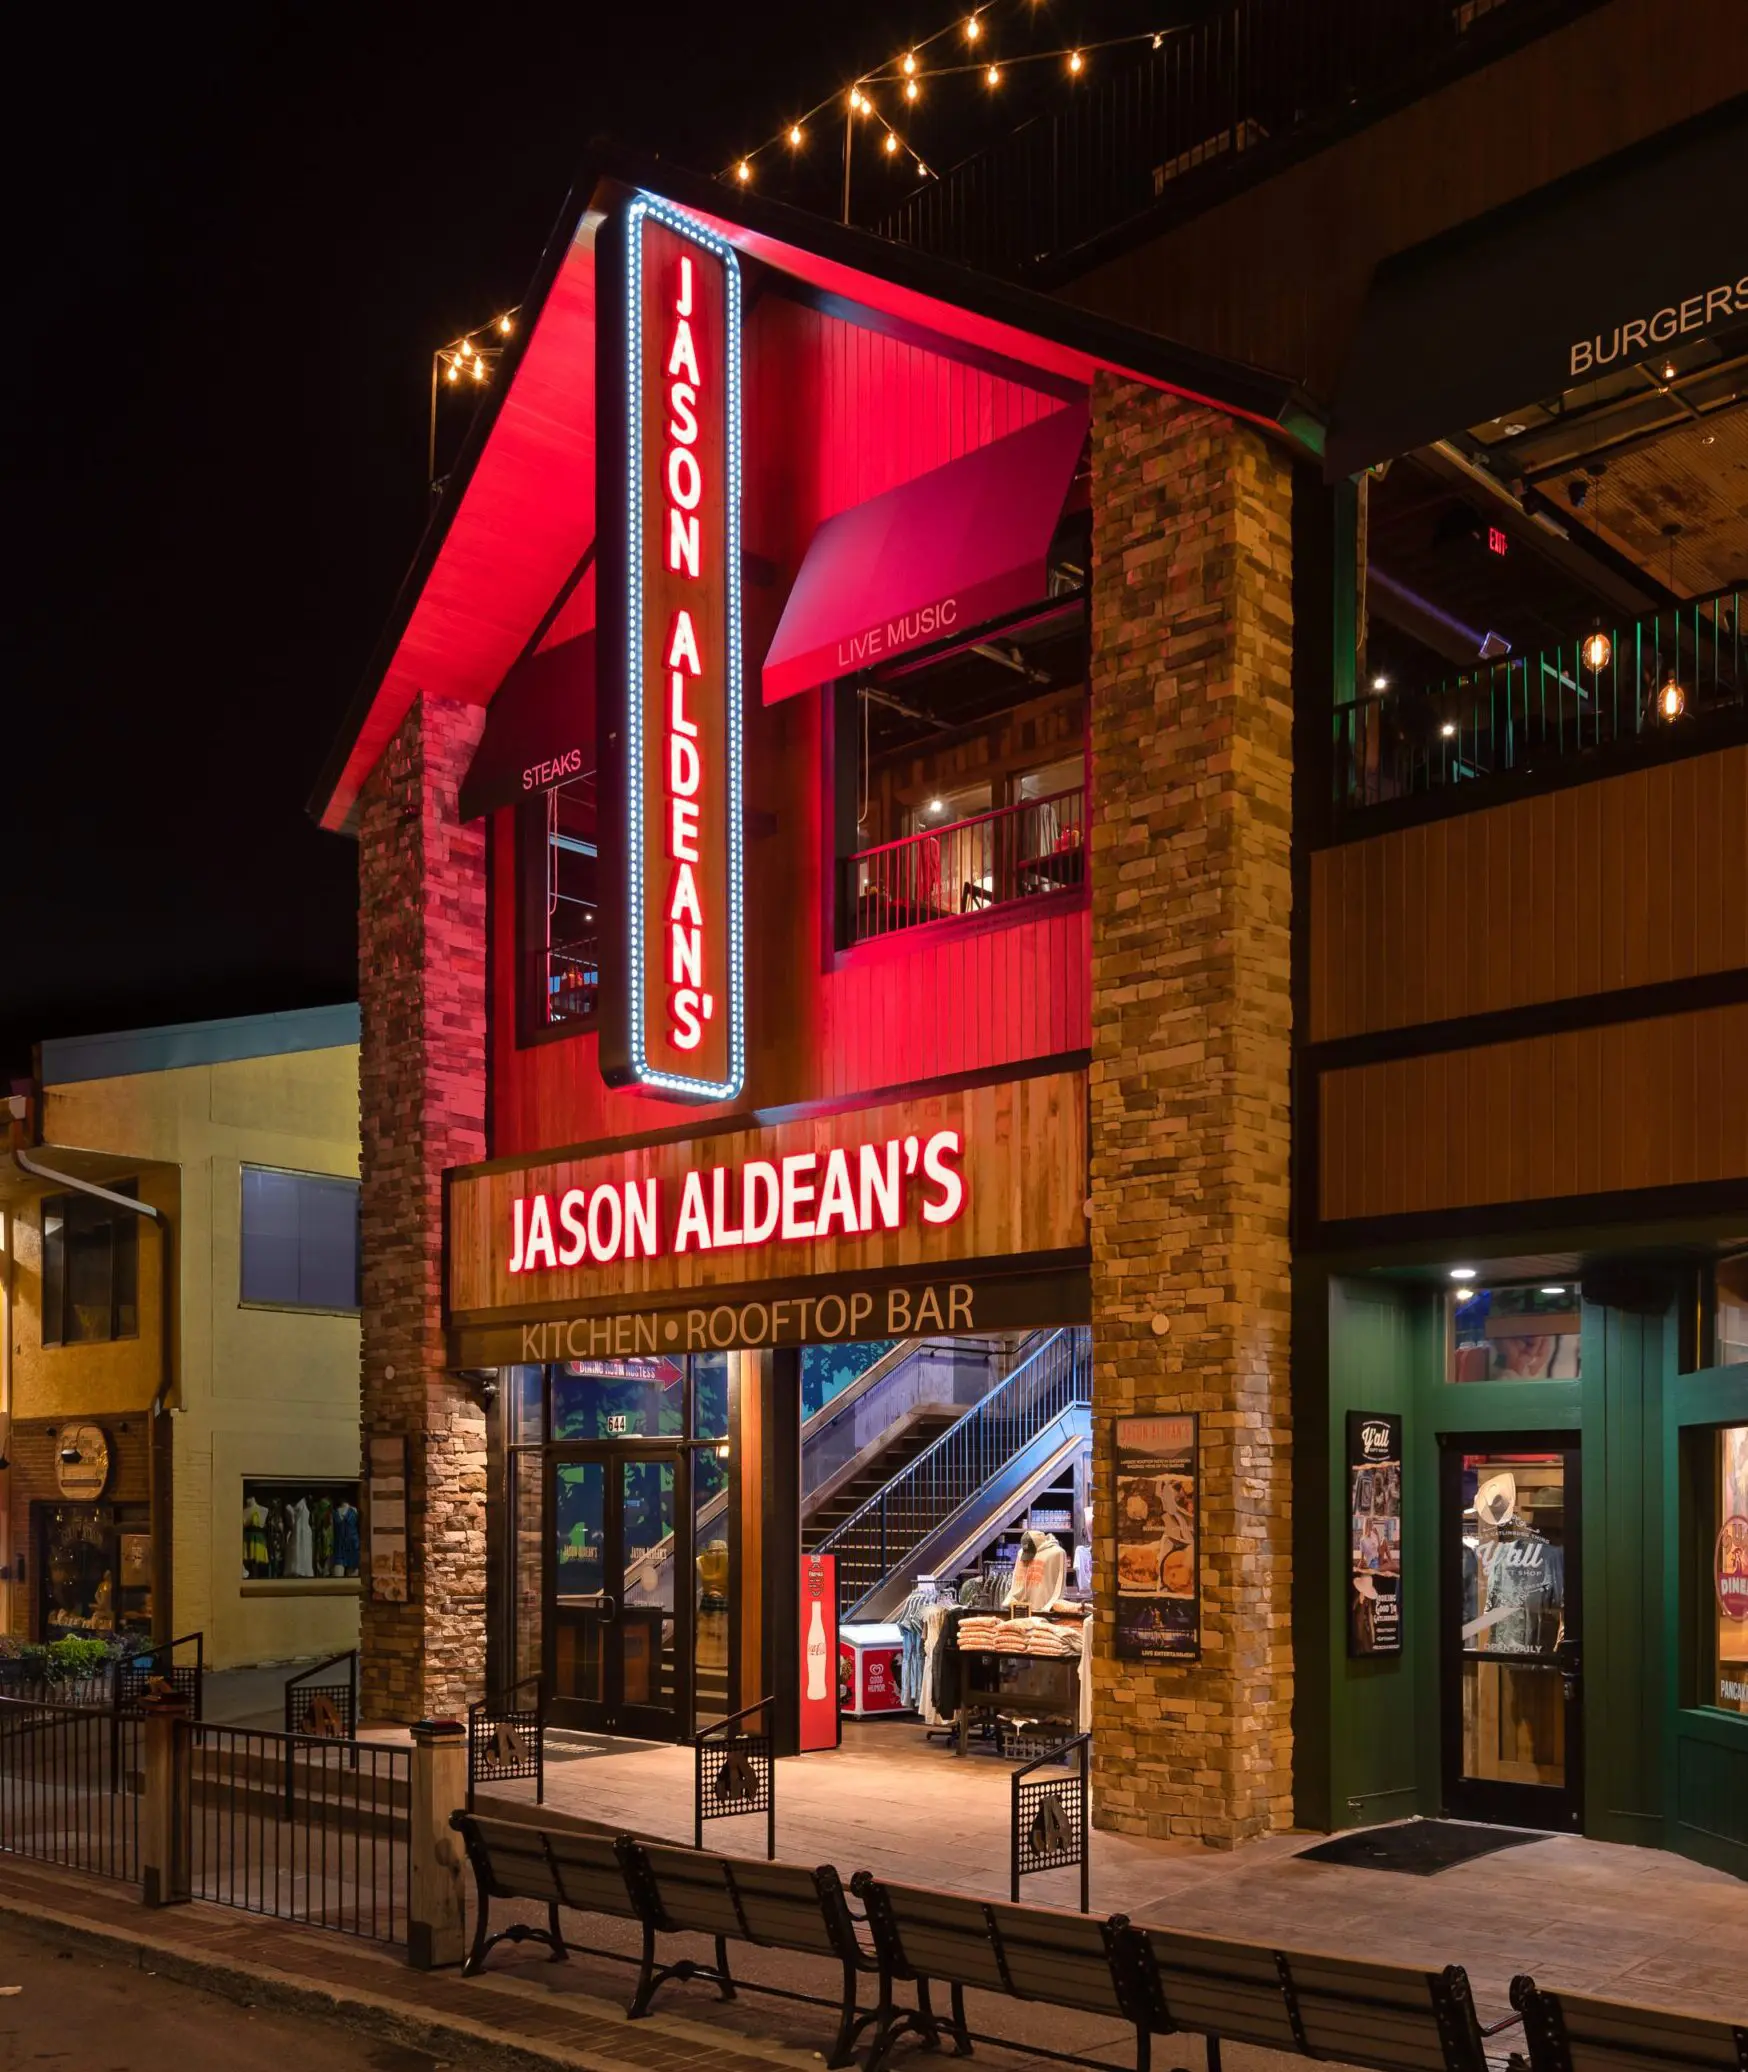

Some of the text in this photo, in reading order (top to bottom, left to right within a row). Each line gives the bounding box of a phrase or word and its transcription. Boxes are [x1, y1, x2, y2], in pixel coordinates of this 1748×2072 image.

[667, 255, 701, 578] JASON
[1489, 527, 1505, 556] EXIT
[838, 599, 957, 667] LIVE MUSIC
[522, 749, 582, 790] STEAKS
[509, 1130, 964, 1273] JASON ALDEAN'S
[521, 1283, 975, 1362] KITCHEN ROOFTOP BAR
[580, 1361, 656, 1379] DINING ROOM HOSTESS
[608, 1417, 626, 1432] 644
[1361, 1426, 1390, 1453] Y'all
[1518, 1569, 1543, 1577] SHOP
[1484, 1643, 1543, 1653] OPEN DAILY
[867, 1684, 886, 1693] HUMOR
[869, 1675, 884, 1684] GOOD
